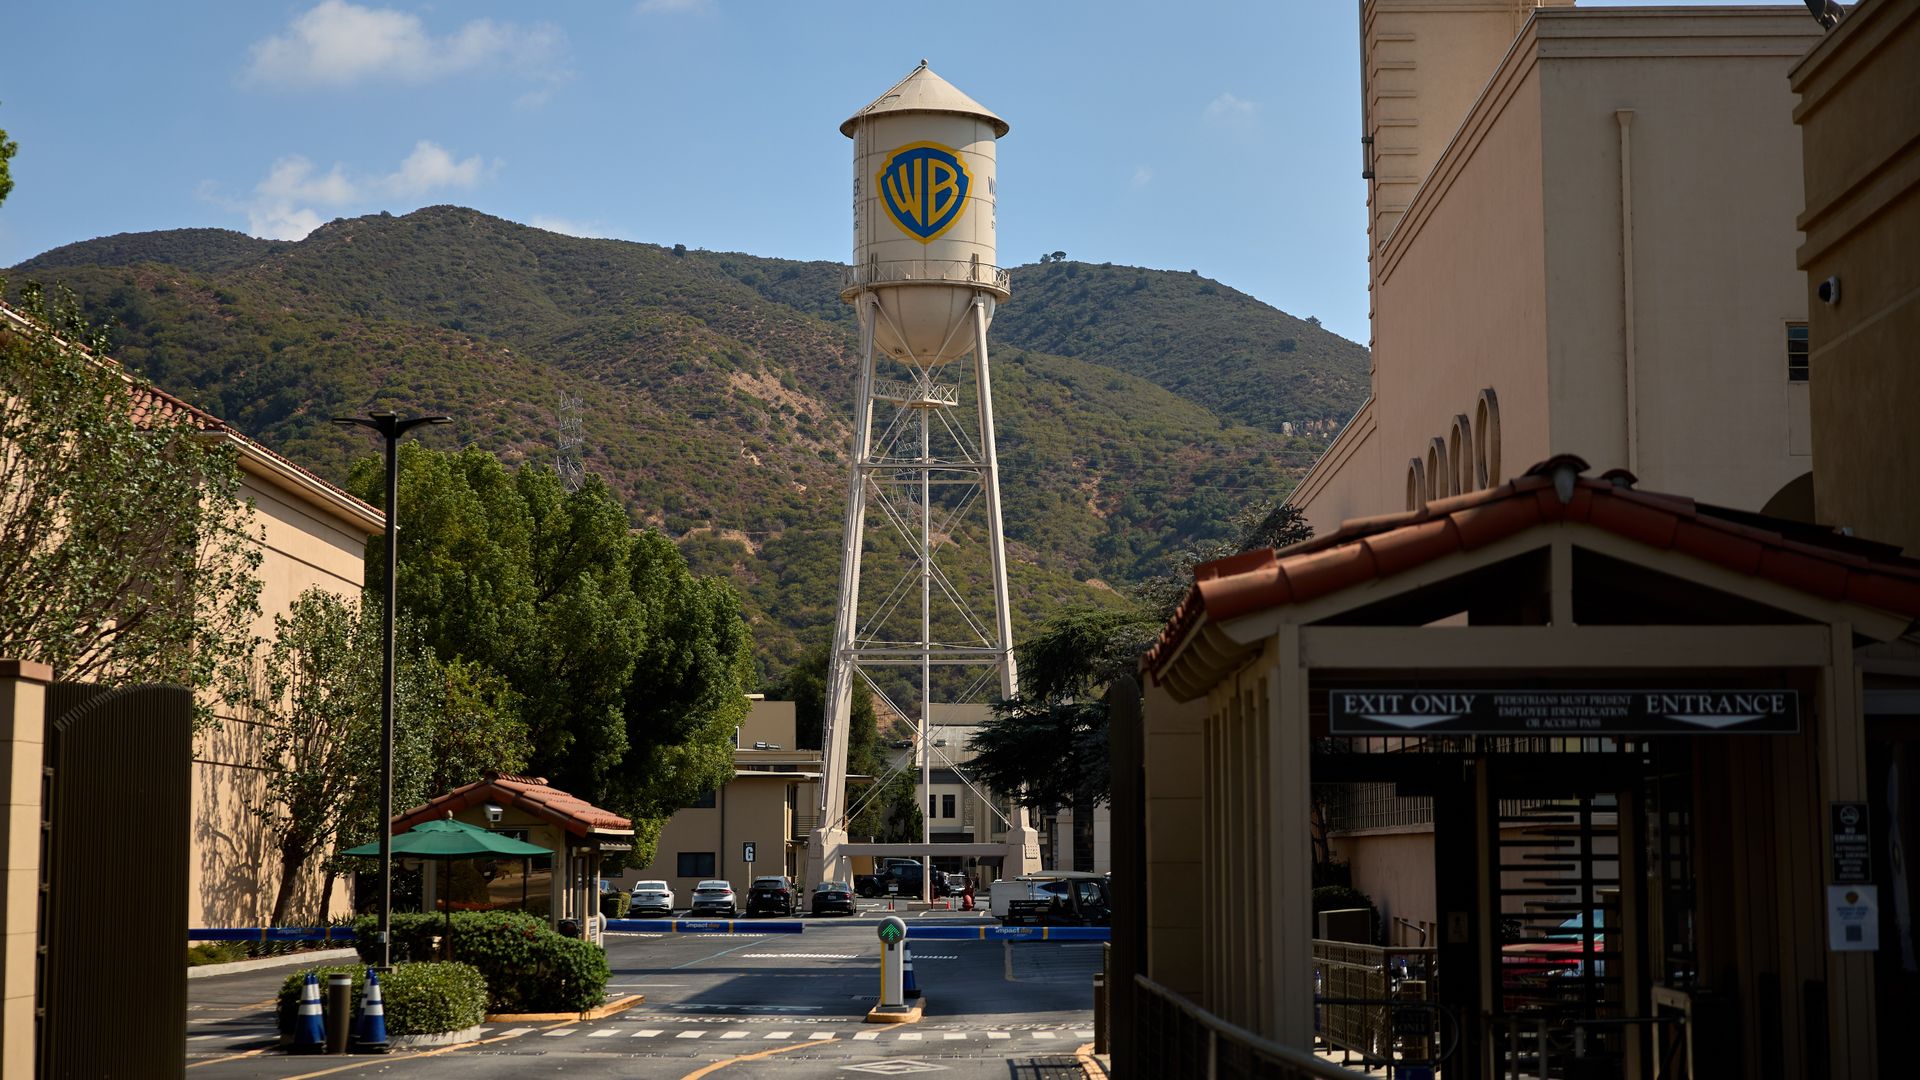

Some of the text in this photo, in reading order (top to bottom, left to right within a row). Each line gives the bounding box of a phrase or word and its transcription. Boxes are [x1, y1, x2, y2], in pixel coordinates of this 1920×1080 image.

[887, 158, 960, 227] WB
[1344, 695, 1476, 714] EXIT ONLY
[1494, 696, 1632, 705] PEDESTRIANS MUST PRESENT
[1646, 695, 1786, 714] ENTRANCE
[1498, 707, 1629, 716] EMPLOYEE IDENTIFICATION
[1526, 719, 1602, 728] OR ACCESS PASS
[745, 846, 754, 862] G
